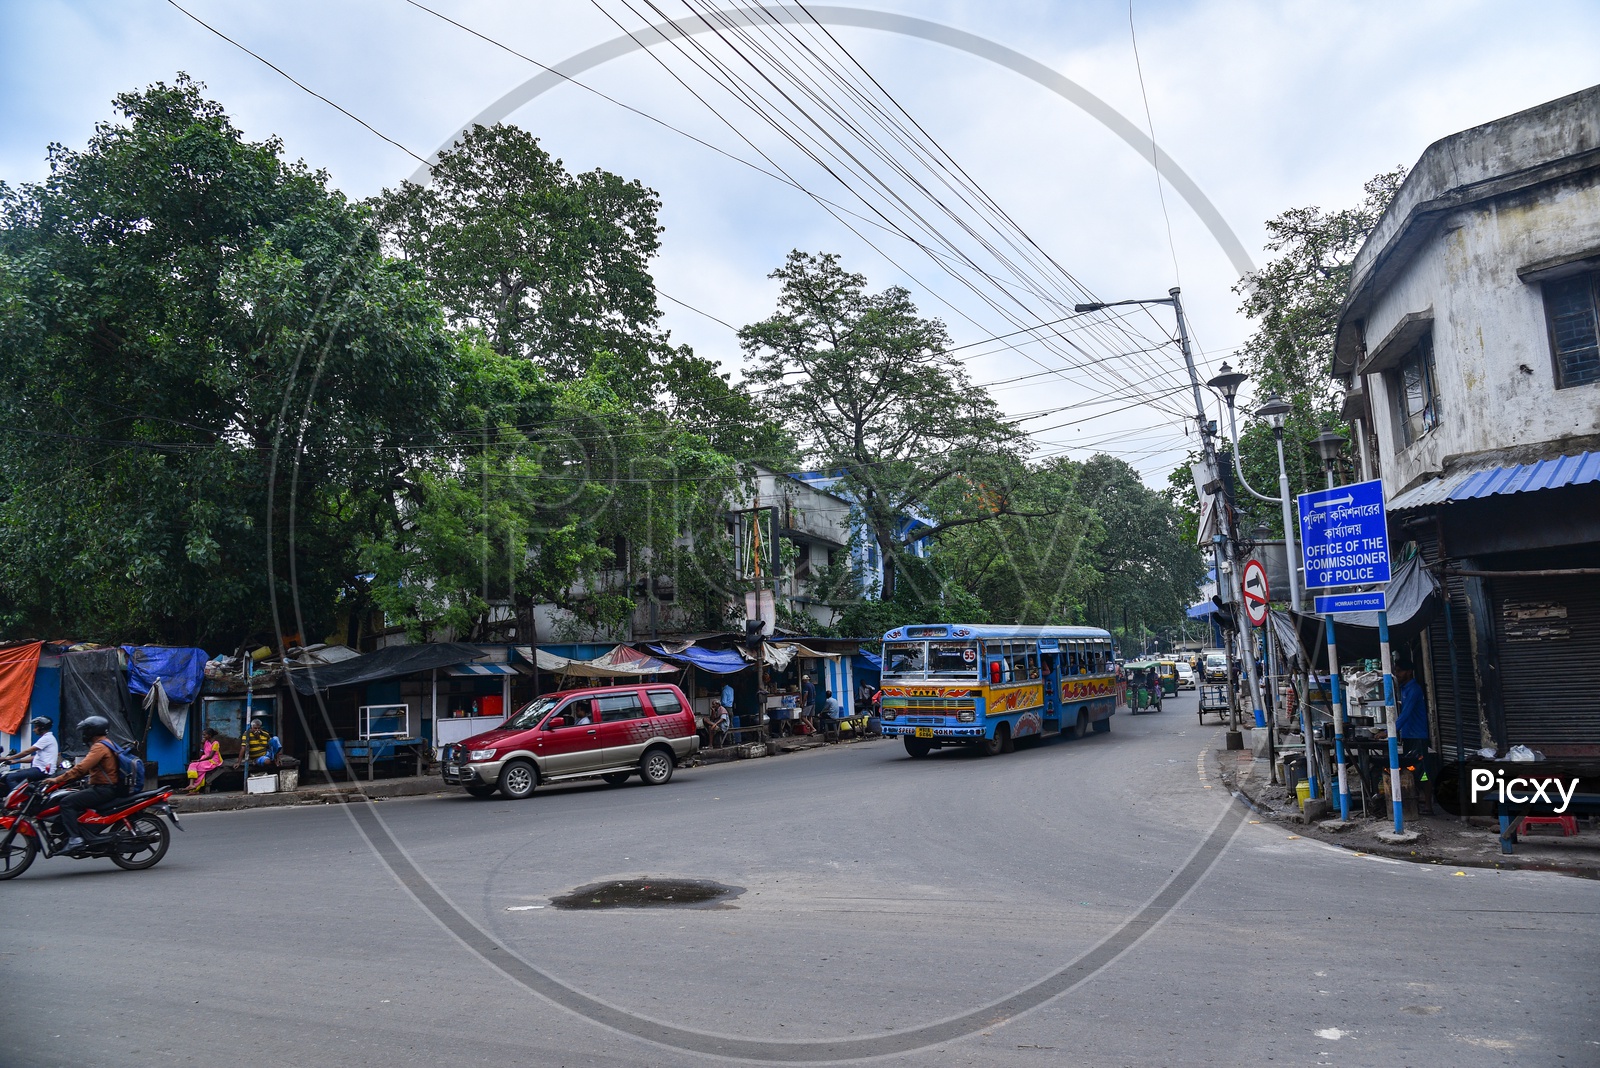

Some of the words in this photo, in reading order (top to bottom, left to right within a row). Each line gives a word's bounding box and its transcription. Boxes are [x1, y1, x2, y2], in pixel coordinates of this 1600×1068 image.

[1303, 510, 1327, 530] পুলিশ
[1330, 503, 1381, 521] কমিশনারের
[1306, 542, 1343, 557] OFFICE
[1345, 540, 1359, 552] OF
[1362, 537, 1384, 550] THE
[1306, 551, 1387, 571] COMMISSIONER
[1319, 571, 1333, 583] OF
[1335, 567, 1374, 582] POLICE
[964, 651, 975, 660] 55
